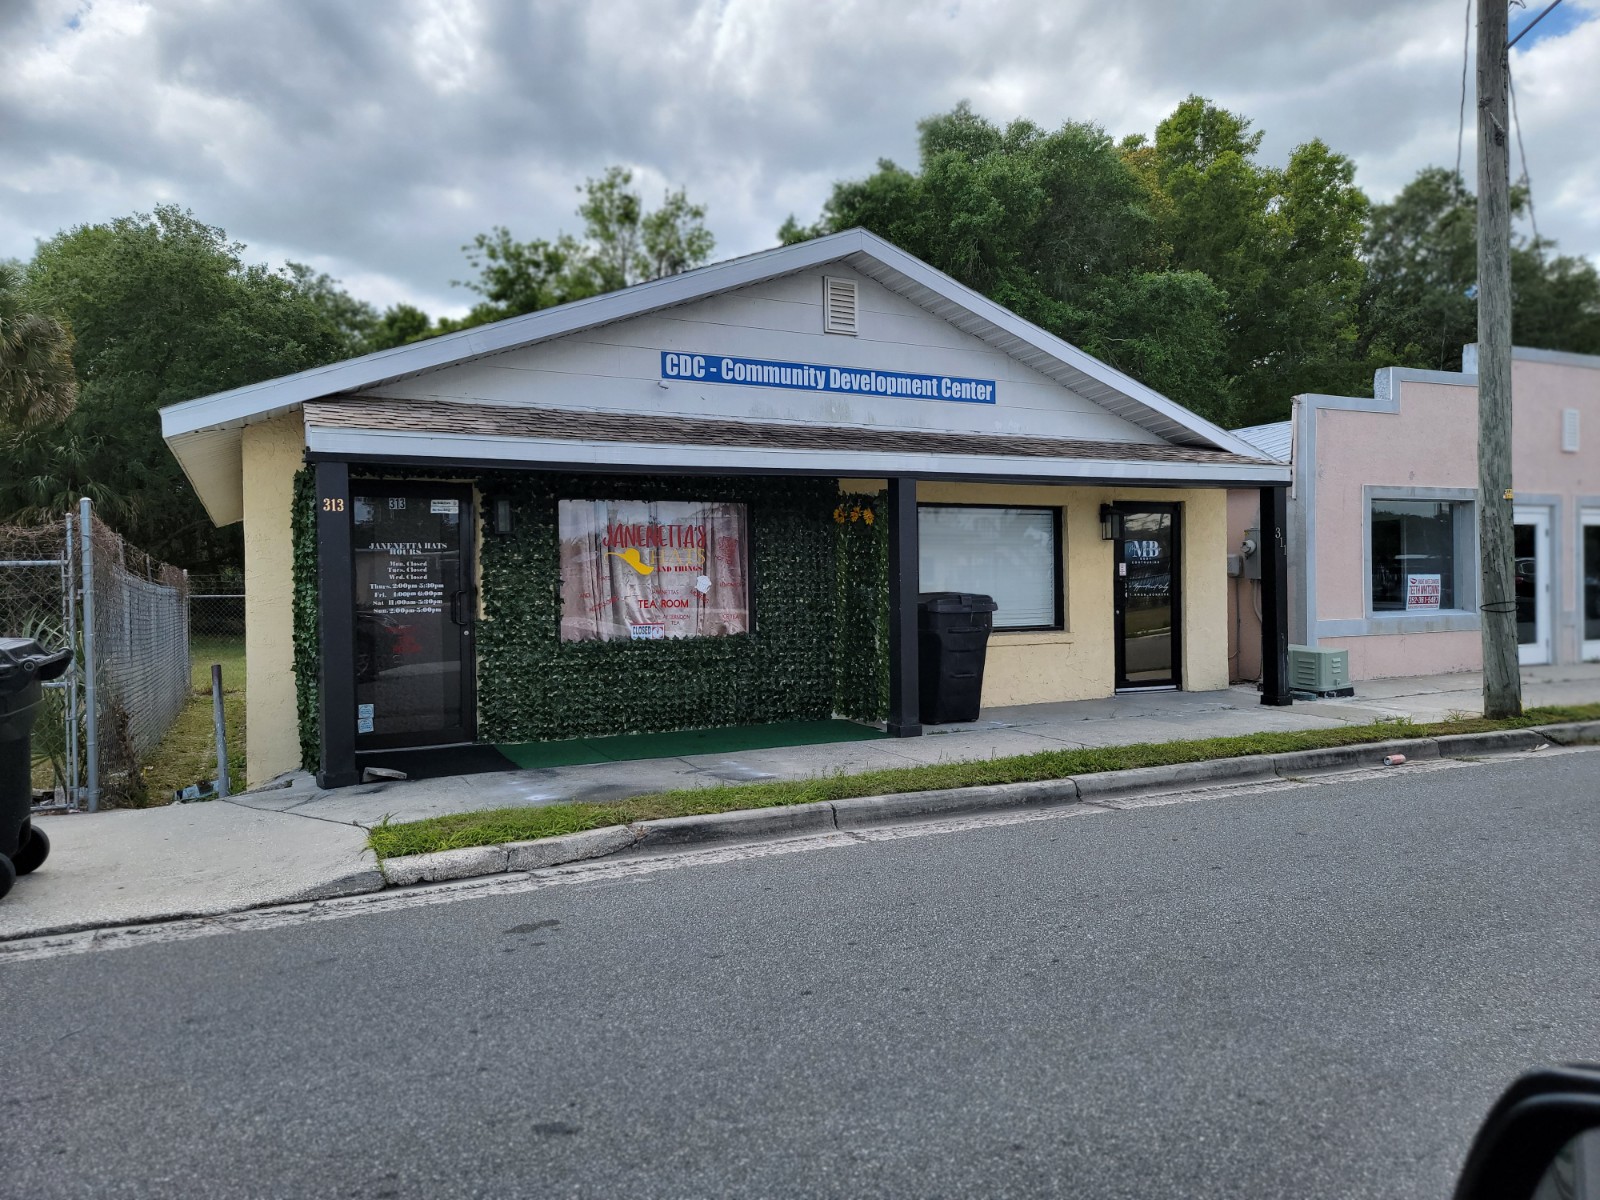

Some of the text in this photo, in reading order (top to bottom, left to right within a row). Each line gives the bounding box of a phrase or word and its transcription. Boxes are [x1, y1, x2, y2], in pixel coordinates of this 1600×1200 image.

[665, 353, 705, 378] CDC
[721, 358, 825, 390] Community
[829, 369, 938, 397] Development
[941, 377, 993, 401] Center
[322, 498, 345, 511] 313
[389, 498, 406, 509] 313
[602, 523, 706, 548] JANENETTA'S
[368, 542, 422, 550] JANENETTA
[1132, 540, 1159, 557] MB
[649, 548, 706, 565] HATS
[637, 599, 689, 609] TEA ROOM
[632, 626, 652, 635] CLOSED
